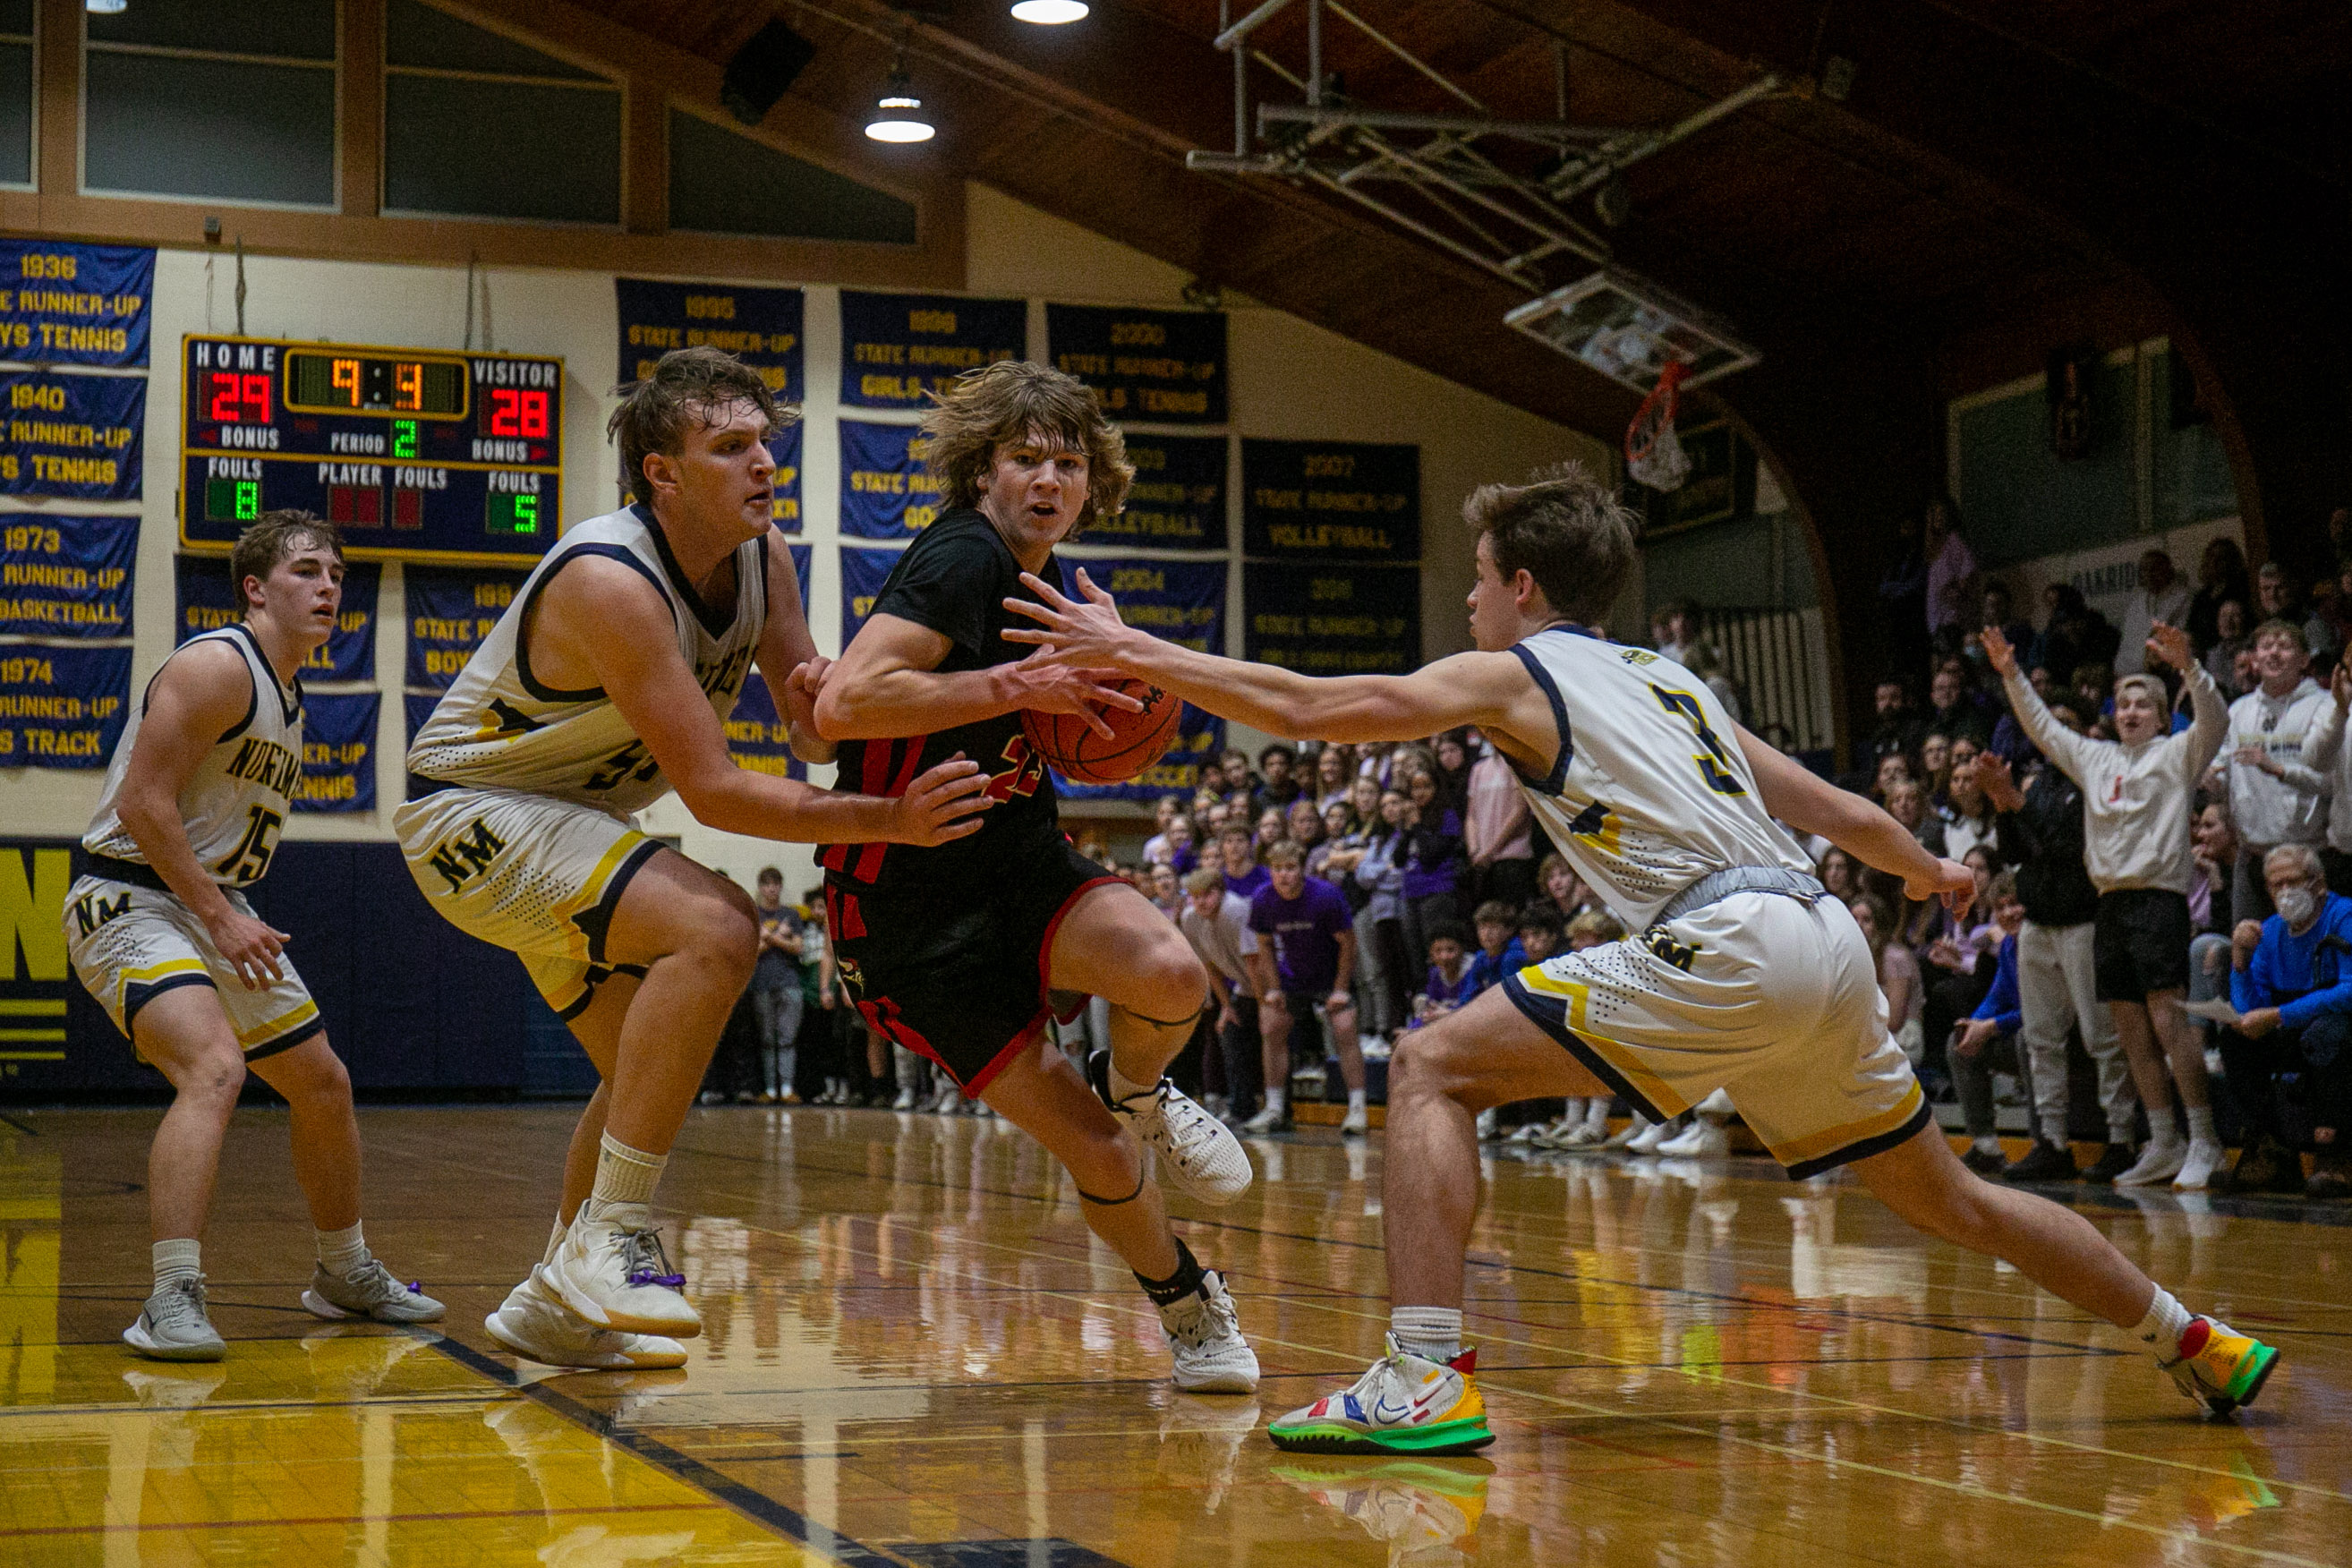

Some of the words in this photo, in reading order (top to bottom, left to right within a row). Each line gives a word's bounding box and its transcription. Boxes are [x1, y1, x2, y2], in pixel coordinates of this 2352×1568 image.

[21, 254, 77, 281] 1936
[20, 291, 141, 317] RUNNER-UP
[39, 323, 127, 353] TENNIS
[196, 343, 277, 371] HOME
[473, 360, 557, 388] VISITOR
[11, 385, 66, 412] 1940
[211, 372, 270, 423] 29
[491, 389, 549, 437] 28
[10, 421, 132, 450] RUNNER-UP
[221, 426, 280, 450] BONUS
[330, 432, 386, 455] PERIOD
[395, 420, 417, 458] 2
[472, 439, 529, 462] BONUS
[31, 454, 118, 484] TENNIS
[208, 456, 263, 481] FOULS
[318, 463, 383, 486] PLAYER
[394, 467, 447, 490] FOULS
[488, 471, 541, 494] FOULS
[851, 471, 904, 494] STATE
[234, 481, 259, 522] 8
[514, 494, 538, 533] 5
[4, 525, 61, 555] 1973
[4, 563, 125, 591] RUNNER-UP
[414, 617, 471, 642] STATE
[0, 658, 53, 685] 1974
[425, 650, 476, 674] BOY
[23, 729, 102, 756] TRACK
[215, 803, 283, 882] 15
[430, 817, 507, 894] NM
[73, 891, 132, 939] NM
